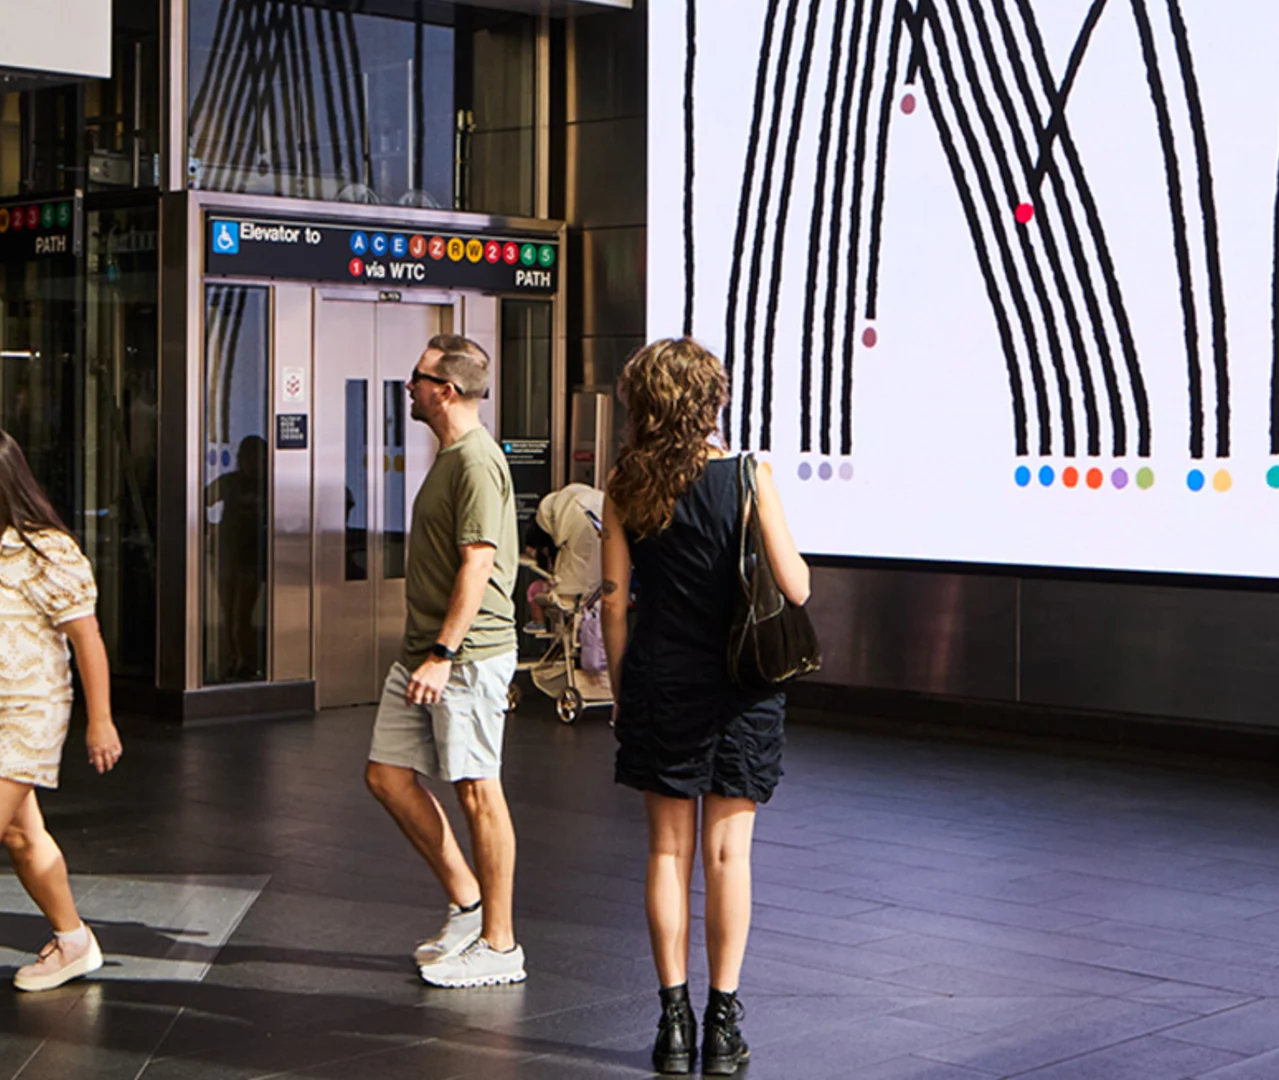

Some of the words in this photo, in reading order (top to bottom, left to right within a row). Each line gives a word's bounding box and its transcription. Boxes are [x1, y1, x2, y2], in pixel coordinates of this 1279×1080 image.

[35, 236, 67, 254] PATH
[240, 224, 300, 243] Elevator
[305, 227, 320, 244] to
[354, 235, 364, 250] A
[375, 237, 384, 251] C
[394, 239, 403, 252] E
[413, 239, 423, 253] J
[432, 241, 442, 255] Z
[451, 243, 462, 257] R
[469, 244, 482, 258] W
[488, 244, 498, 259] 2
[506, 246, 516, 261] 3
[524, 247, 533, 261] 4
[542, 249, 551, 262] 5
[366, 263, 385, 280] via
[390, 264, 425, 281] WTC
[516, 271, 551, 288] PATH
